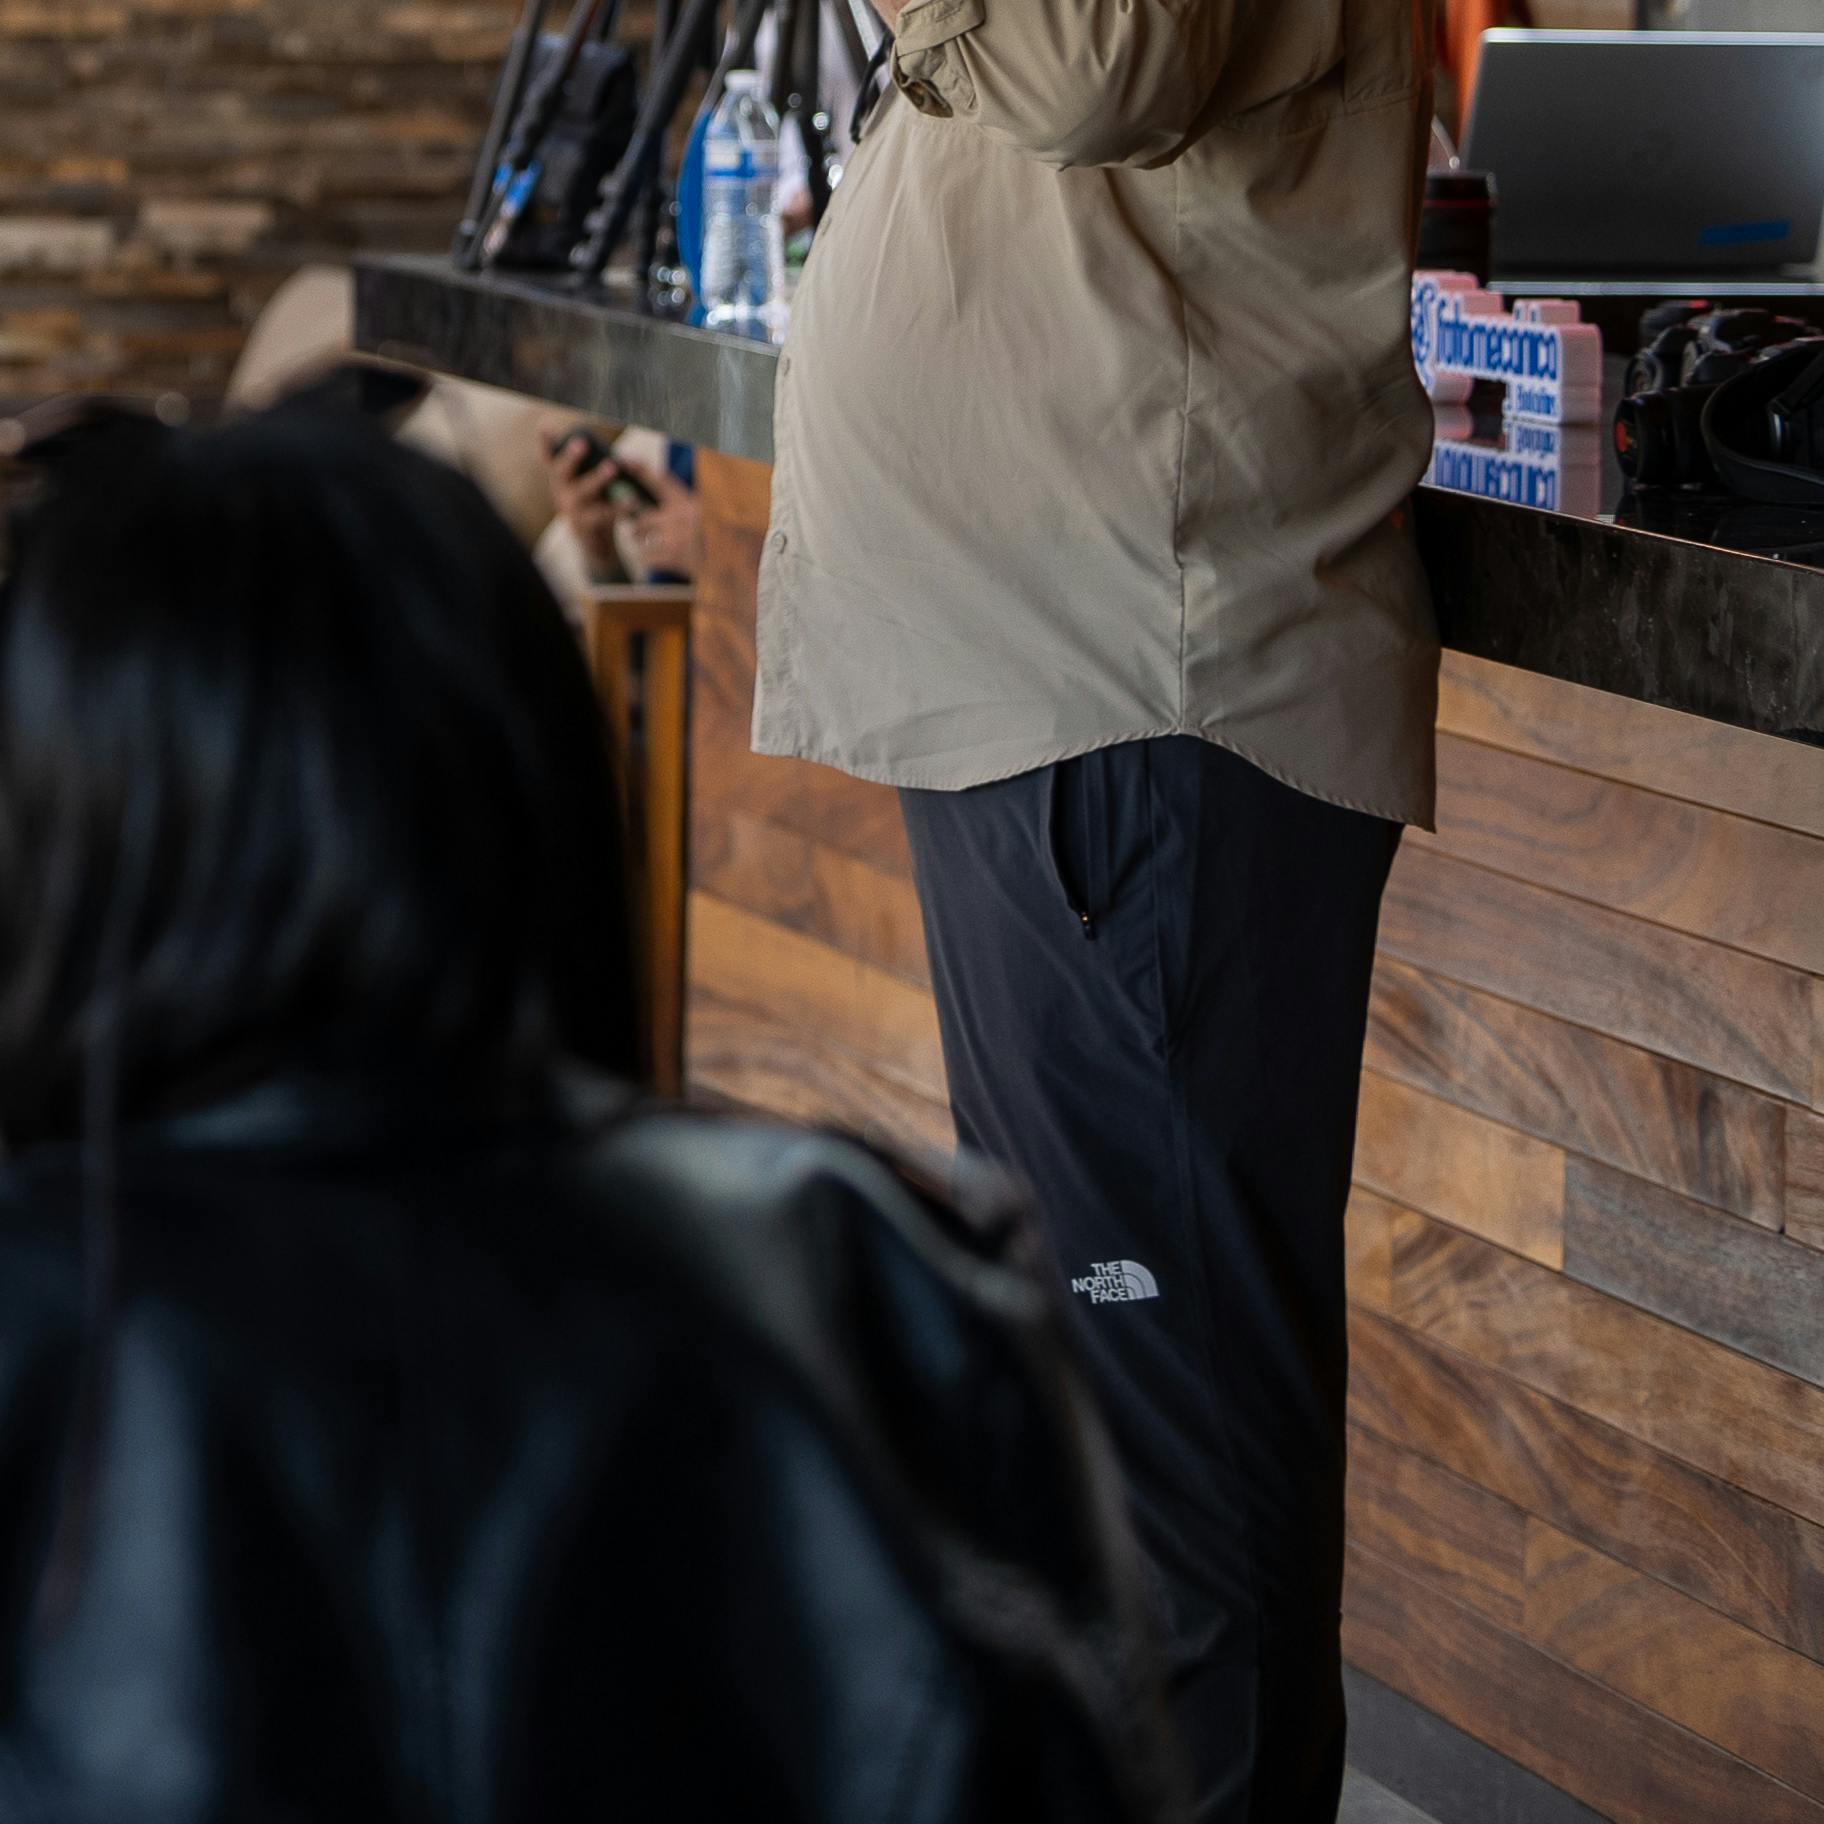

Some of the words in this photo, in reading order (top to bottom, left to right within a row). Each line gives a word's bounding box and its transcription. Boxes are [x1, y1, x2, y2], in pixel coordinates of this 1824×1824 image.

[1090, 1261, 1121, 1276] THE
[1071, 1275, 1124, 1293] NORTH
[1090, 1288, 1129, 1304] FACE
